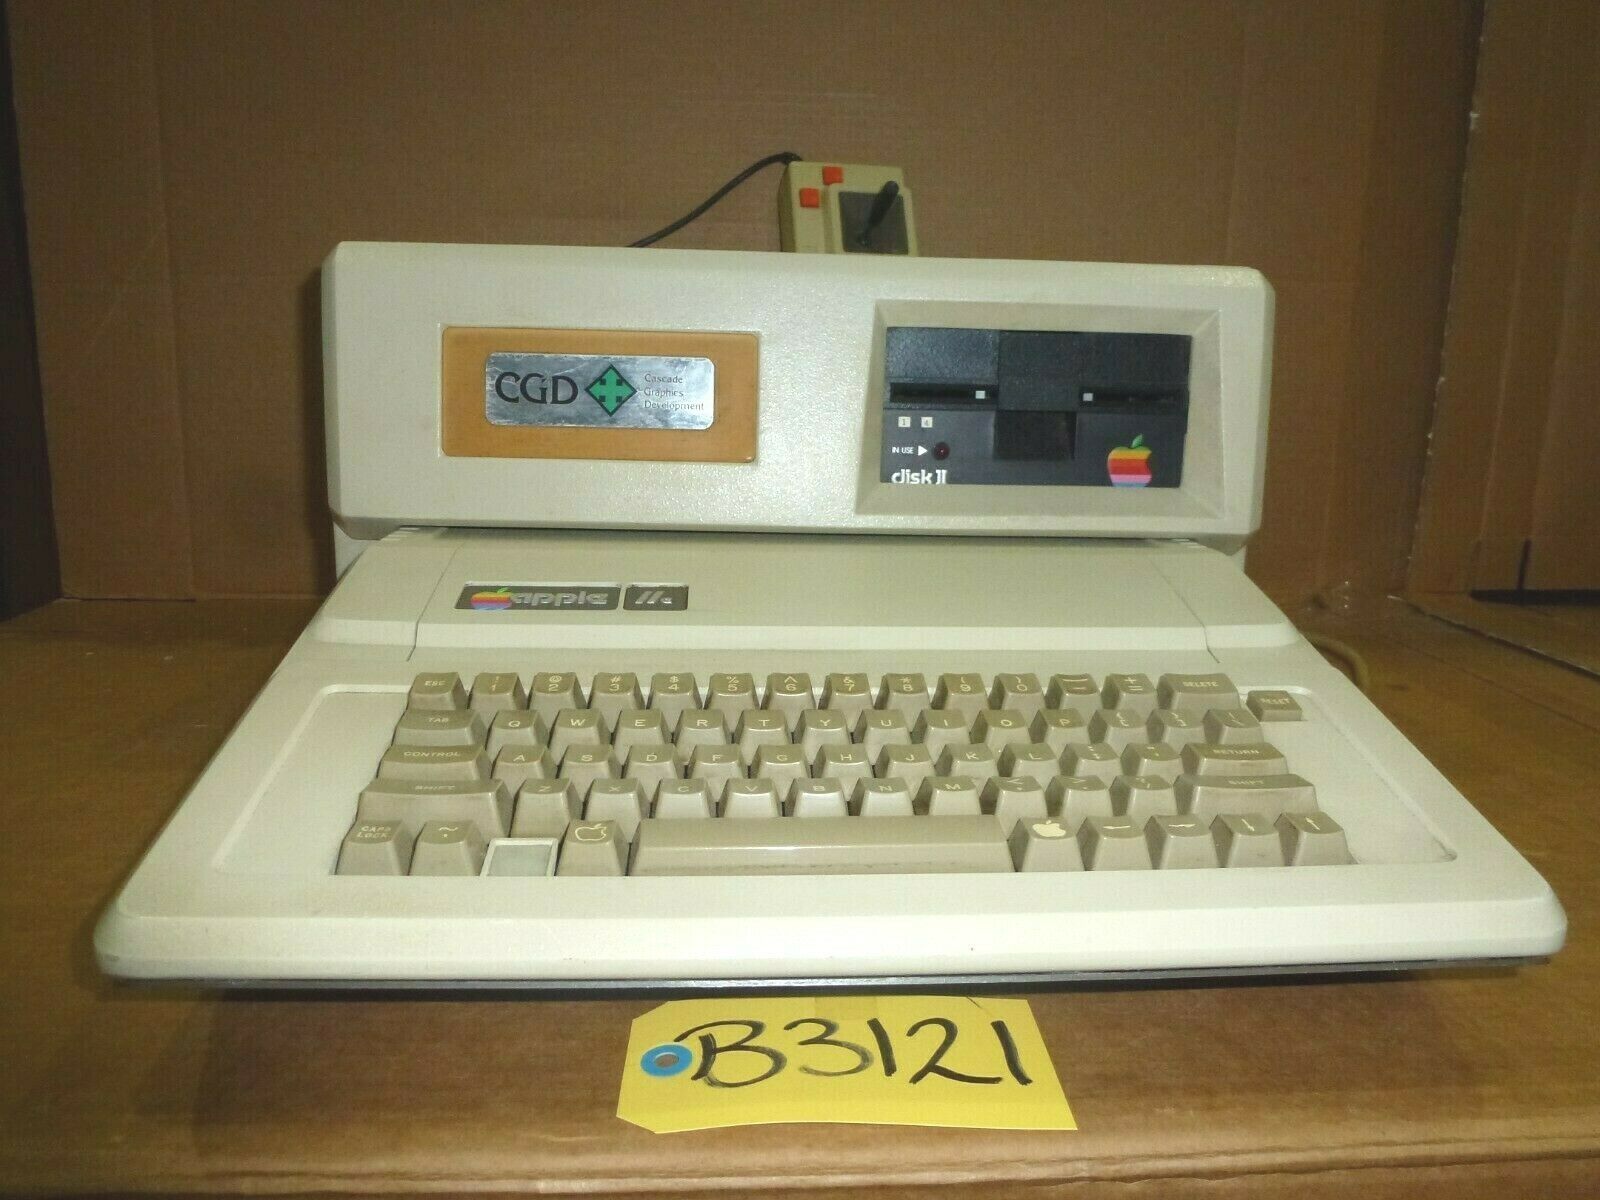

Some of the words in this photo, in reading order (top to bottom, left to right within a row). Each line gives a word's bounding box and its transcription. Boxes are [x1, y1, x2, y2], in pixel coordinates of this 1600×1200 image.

[644, 373, 683, 384] Cascade
[495, 371, 579, 405] CGD
[643, 386, 685, 399] Graphics
[643, 399, 705, 411] Development
[891, 446, 900, 454] IN
[901, 446, 914, 454] USE
[891, 468, 933, 485] disk
[510, 590, 609, 607] apple
[508, 720, 520, 728] Q
[570, 718, 586, 727] W
[634, 719, 646, 727] E
[696, 719, 708, 727] R
[758, 719, 770, 727] T
[820, 719, 832, 727] Y
[880, 719, 892, 727] U
[1059, 718, 1071, 726] P
[513, 754, 526, 762] A
[581, 754, 593, 762] S
[646, 753, 658, 762] D
[712, 754, 723, 762] F
[776, 754, 788, 762] G
[965, 752, 979, 760] K
[945, 783, 961, 791] M
[673, 1017, 1034, 1089] B3121
